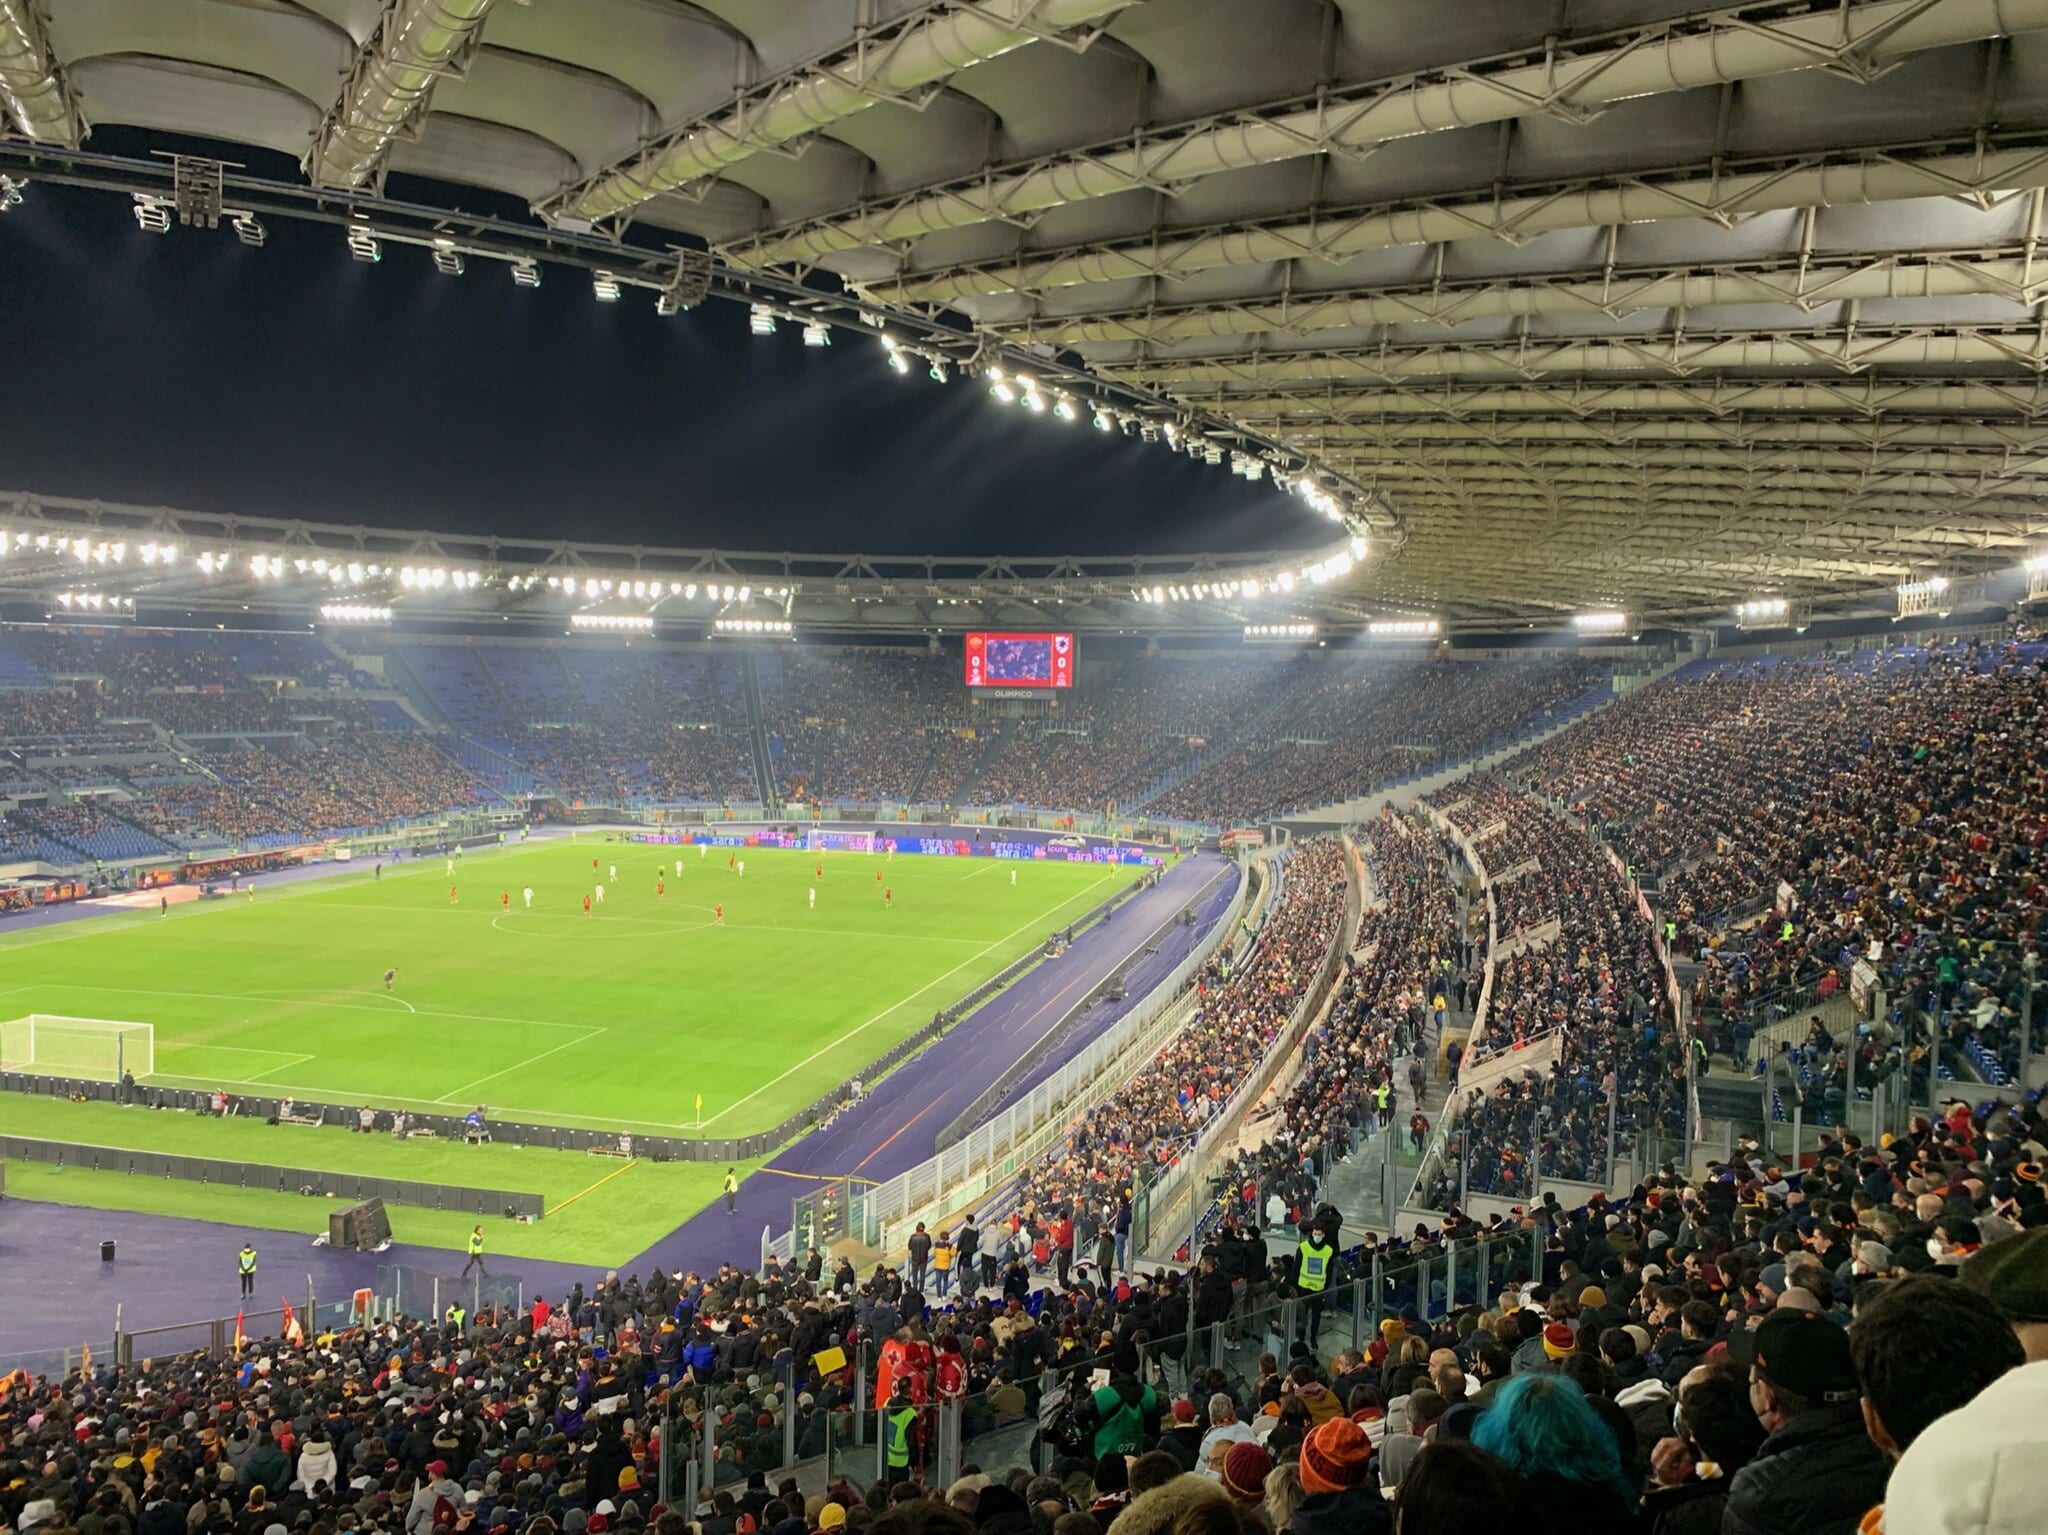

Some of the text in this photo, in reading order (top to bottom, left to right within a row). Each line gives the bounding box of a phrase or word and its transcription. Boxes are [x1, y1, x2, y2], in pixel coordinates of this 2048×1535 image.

[971, 656, 980, 667] 0
[1057, 657, 1066, 668] 0
[995, 690, 1033, 698] OLIMPICO
[711, 836, 735, 846] sara
[778, 839, 801, 848] sara
[921, 846, 946, 855] sara
[995, 849, 1020, 858] sara
[1067, 852, 1092, 862] sara
[1118, 1442, 1136, 1453] 077
